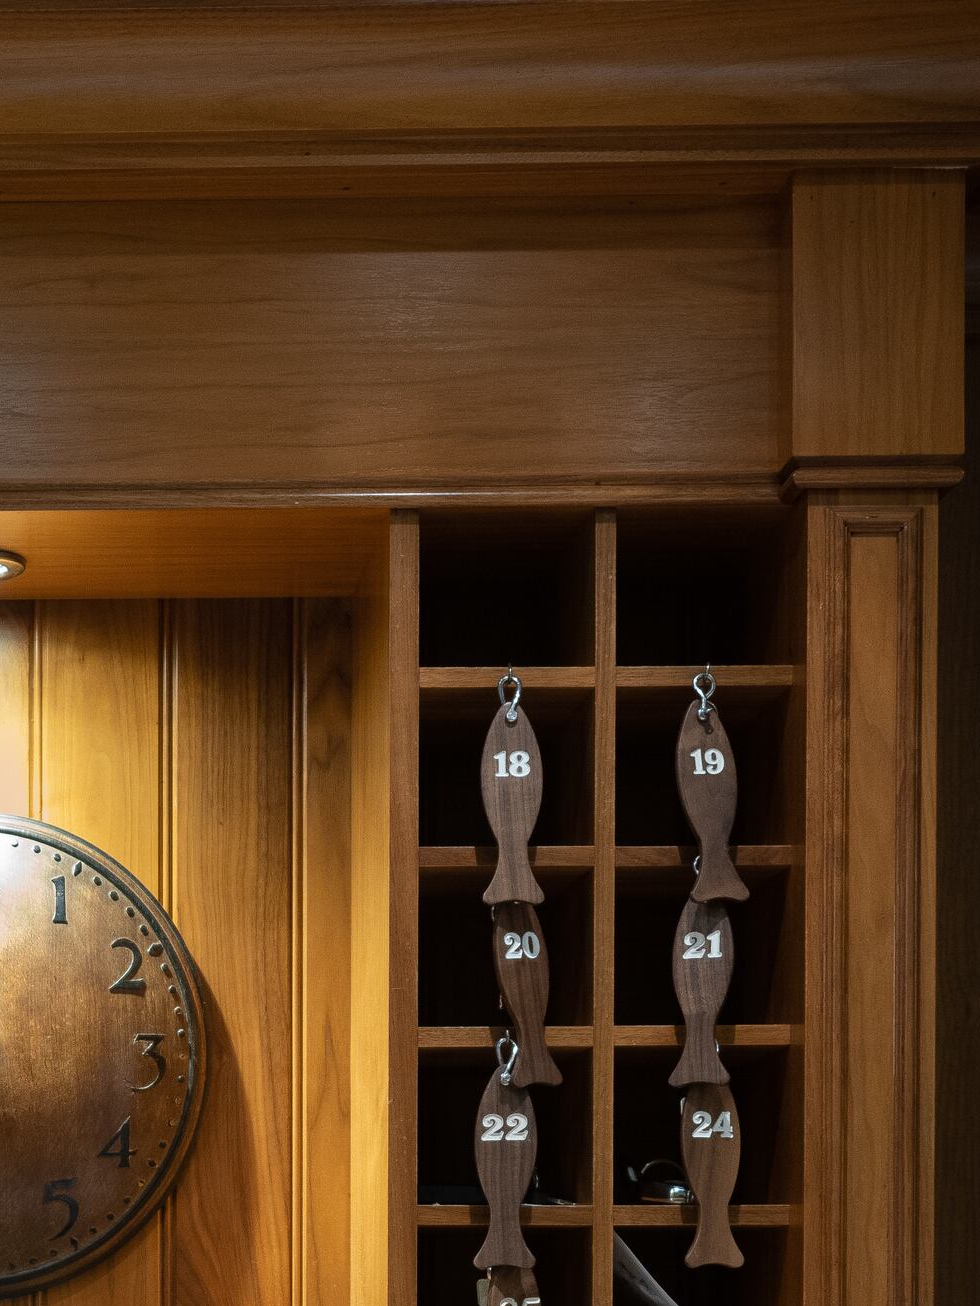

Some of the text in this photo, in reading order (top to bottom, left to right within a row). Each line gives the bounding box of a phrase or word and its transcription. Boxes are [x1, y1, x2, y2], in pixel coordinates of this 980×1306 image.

[492, 750, 531, 778] 18
[689, 747, 725, 775] 19
[51, 876, 68, 924] 1
[503, 931, 541, 960] 20
[681, 929, 723, 960] 21
[109, 938, 146, 993] 2
[130, 1034, 166, 1093] 3
[480, 1112, 529, 1142] 22
[691, 1110, 734, 1139] 24
[98, 1115, 135, 1168] 4
[45, 1178, 78, 1241] 5
